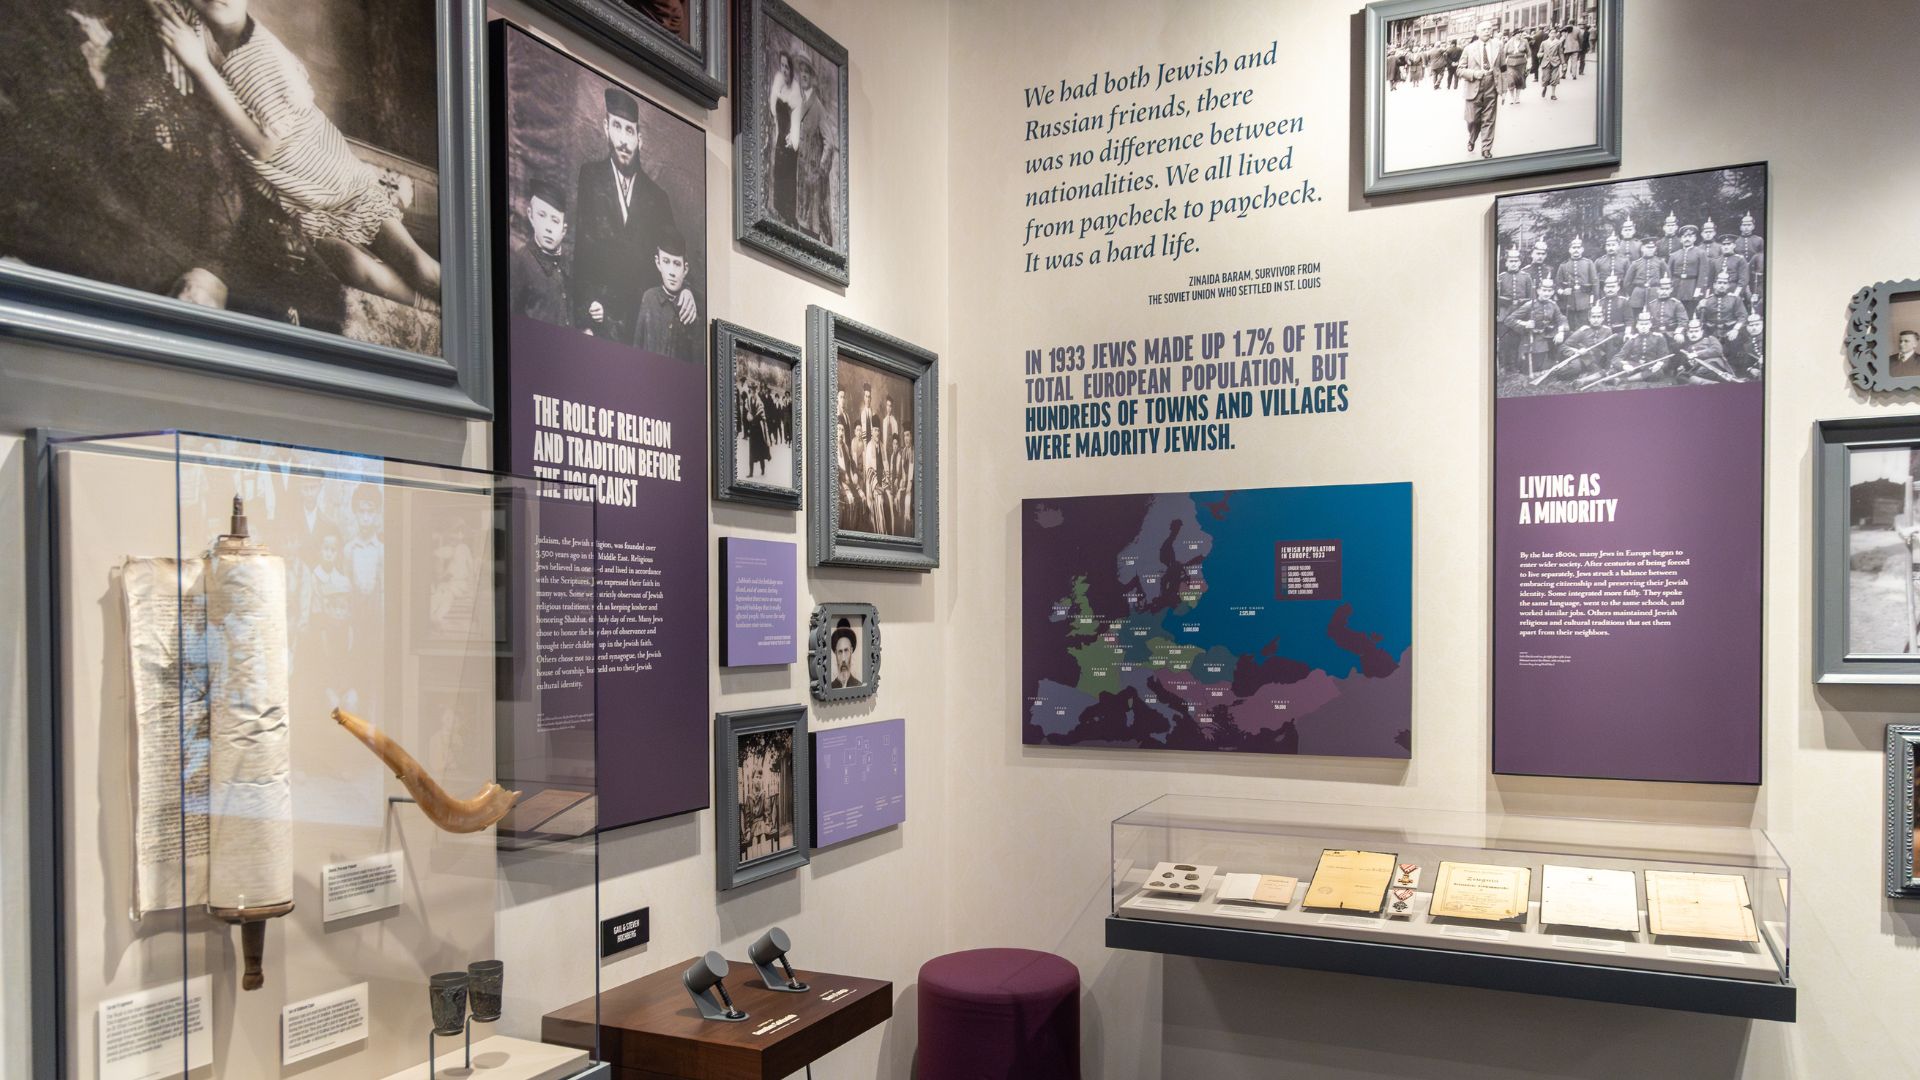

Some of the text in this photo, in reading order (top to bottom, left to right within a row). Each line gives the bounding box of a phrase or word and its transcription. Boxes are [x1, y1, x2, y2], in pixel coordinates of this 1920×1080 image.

[1023, 40, 1277, 108] We had both Jewish and
[1023, 88, 1253, 141] Russian friends, there
[1024, 116, 1302, 174] was no difference between
[1025, 146, 1292, 207] nationalities. We all lived
[1022, 180, 1321, 246] from paycheck to paycheck.
[1024, 231, 1199, 272] It was a hard life.
[1188, 262, 1320, 286] ZINAIDA BARAM, SURVIVOR FROM
[1147, 276, 1320, 305] THE SOVIET UNION WHO SETTLED IN ST. LOUIS
[1025, 320, 1348, 375] IN 1933 JEWS MADE UP 1.7% OF THE
[1024, 352, 1348, 403] TOTAL EUROPEAN POPULATION, BUT
[532, 393, 671, 449] THE ROLE OF RELIGION
[1025, 383, 1348, 432] HUNDREDS OF TOWNS AND VILLAGES
[533, 430, 681, 481] AND TRADITION BEFORE
[1024, 422, 1235, 460] WERE MAJORITY JEWISH.
[534, 466, 638, 507] THE HOLOCAUST
[1519, 472, 1600, 498] LIVING AS
[1518, 498, 1618, 524] A MINORITY
